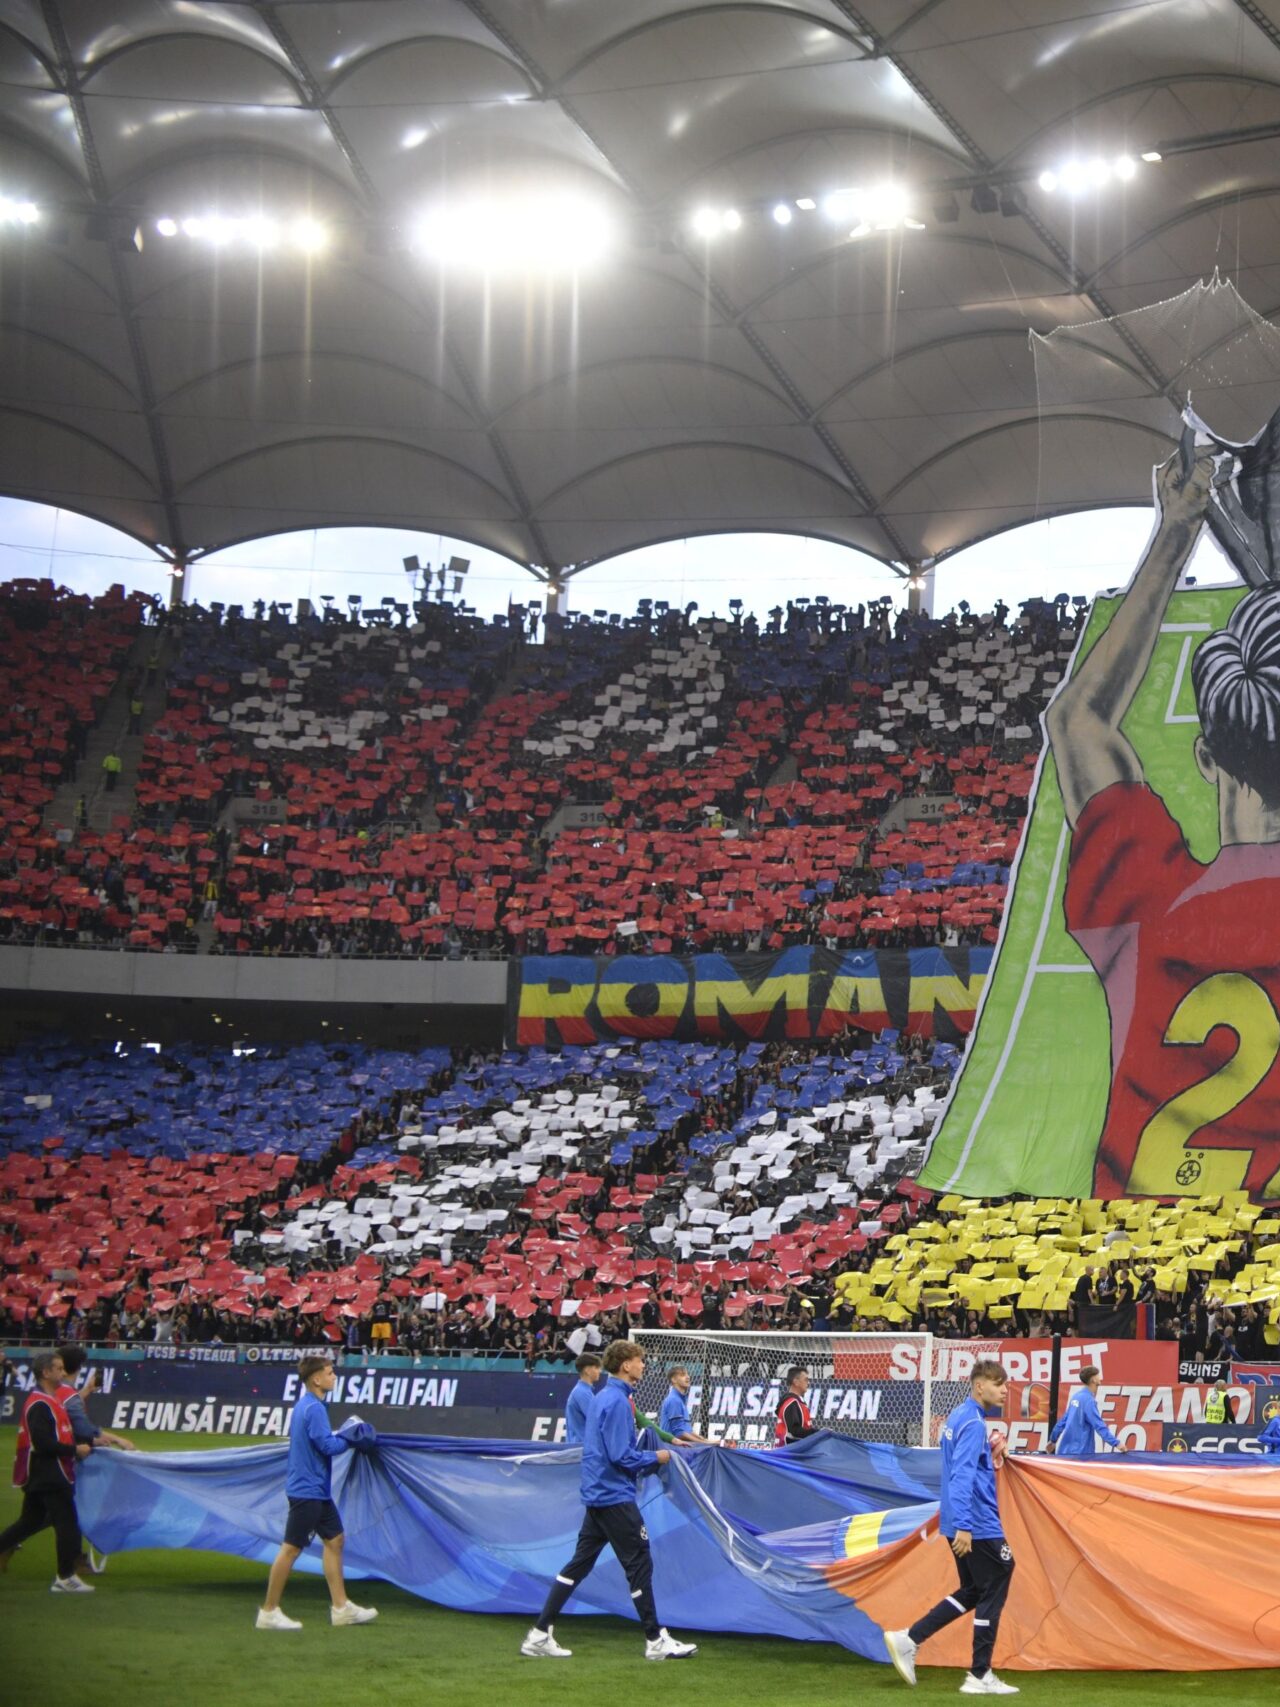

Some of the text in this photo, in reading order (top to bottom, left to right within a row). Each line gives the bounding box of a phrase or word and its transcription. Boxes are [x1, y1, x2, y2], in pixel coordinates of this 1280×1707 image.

[146, 1346, 175, 1359] FCSB
[188, 1348, 236, 1362] STEAUA
[889, 1342, 1108, 1382] SUPRBET
[1179, 1362, 1221, 1377] SKINS
[345, 1368, 376, 1404] SĂ
[378, 1377, 409, 1405] FII
[410, 1377, 458, 1407] FAN
[823, 1388, 883, 1420] FAN
[1067, 1385, 1251, 1425] ETANO
[112, 1401, 130, 1428] E
[130, 1401, 181, 1432] FUN
[181, 1396, 217, 1434] SĂ
[217, 1404, 252, 1435] FII
